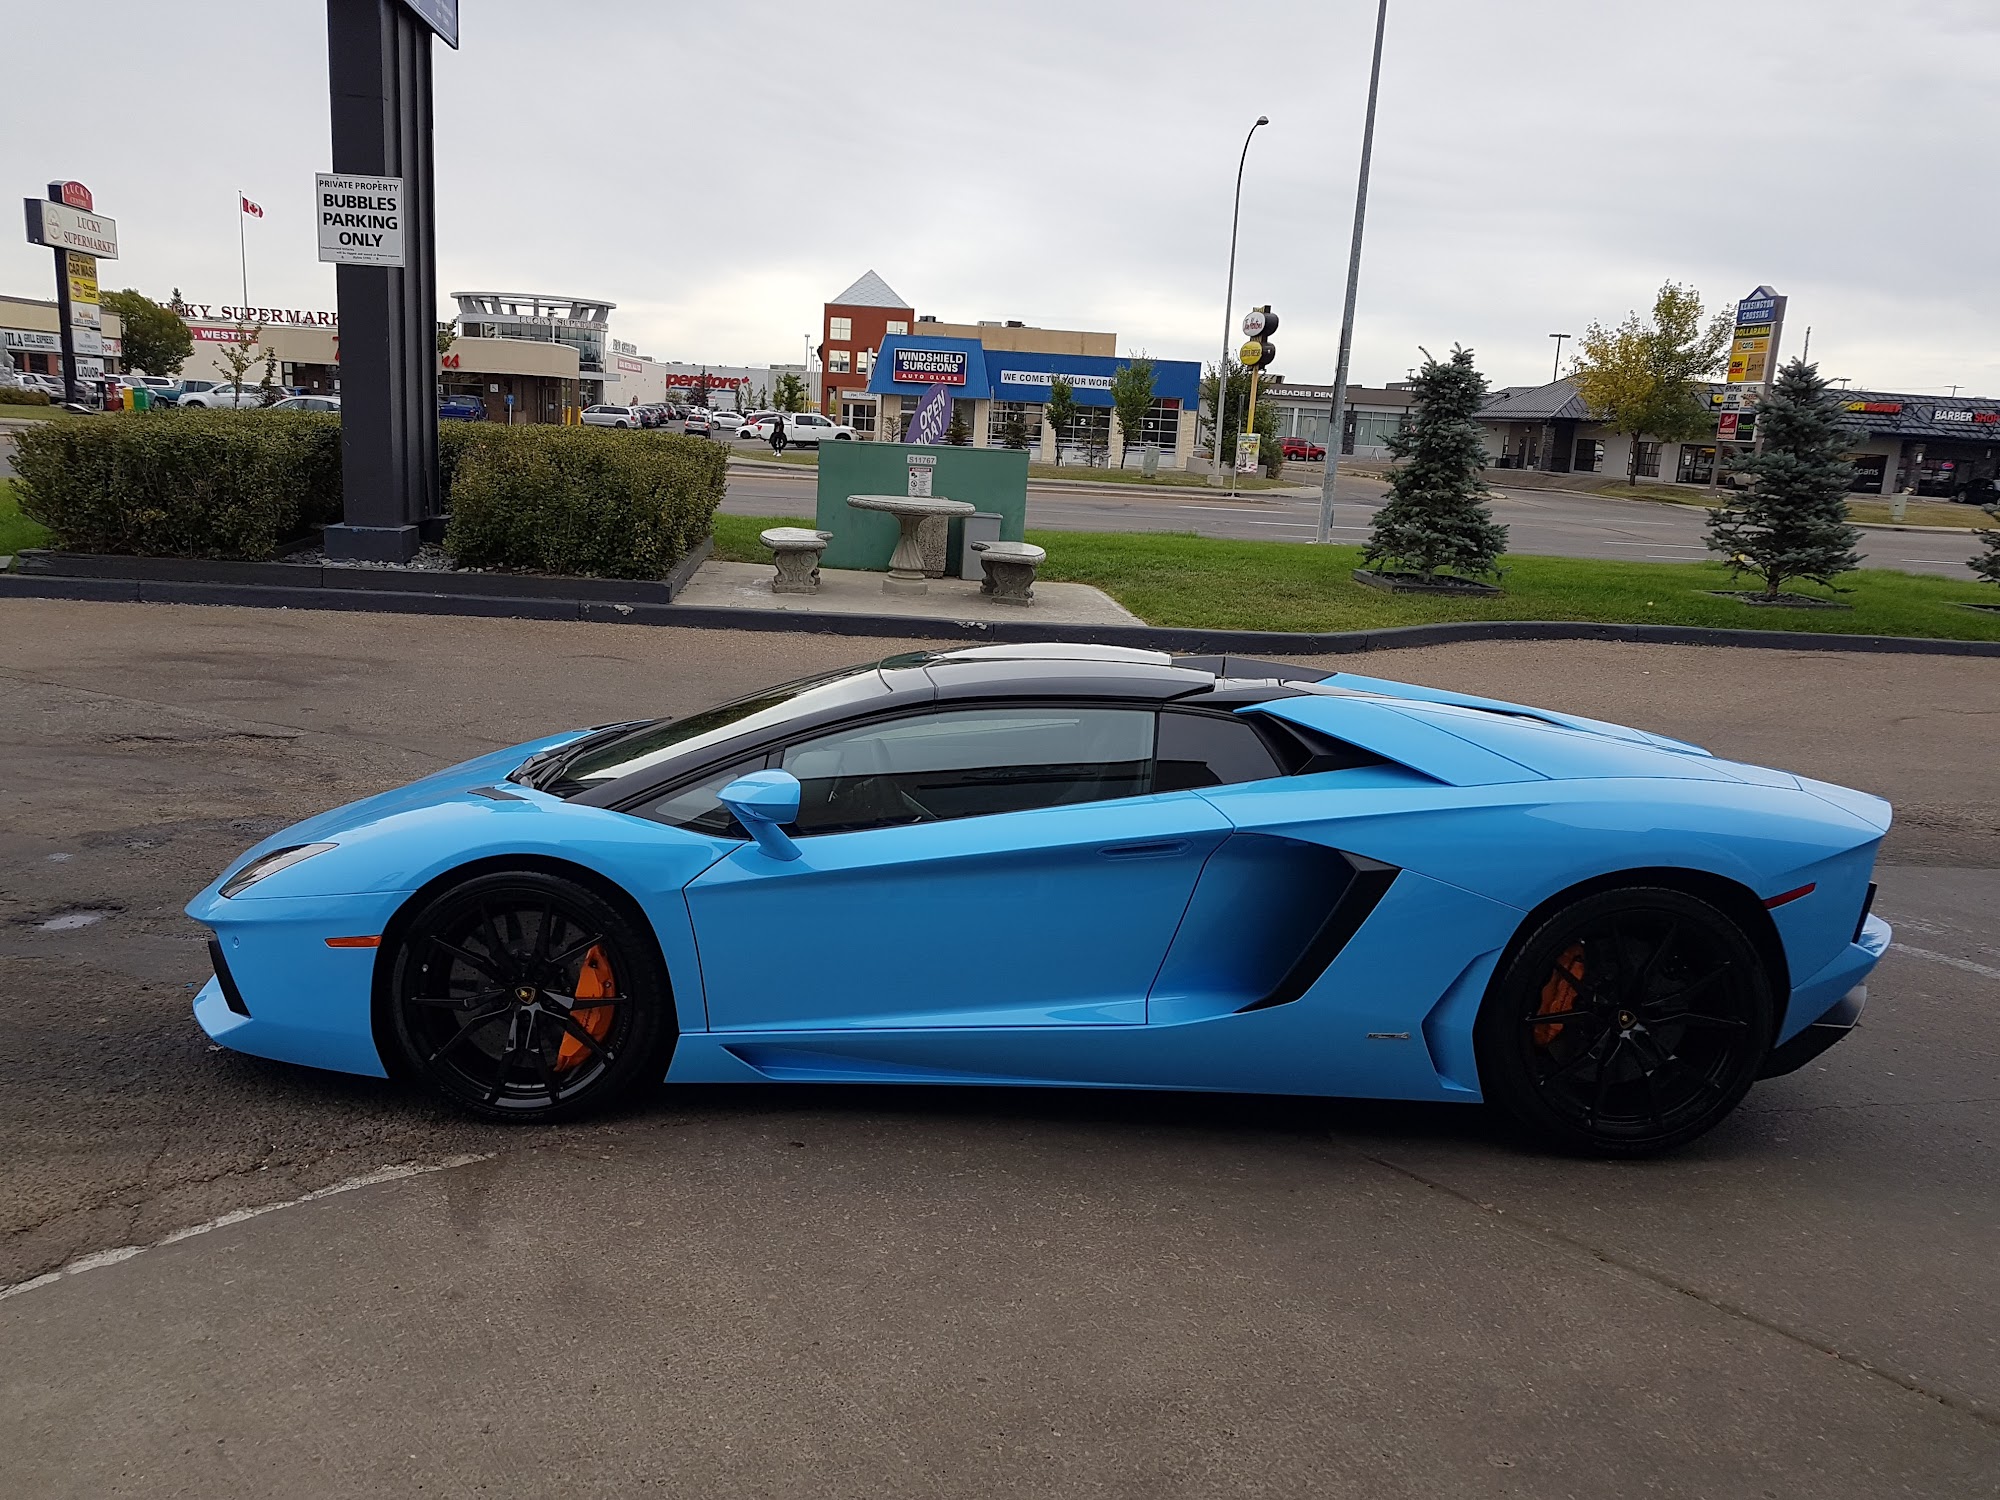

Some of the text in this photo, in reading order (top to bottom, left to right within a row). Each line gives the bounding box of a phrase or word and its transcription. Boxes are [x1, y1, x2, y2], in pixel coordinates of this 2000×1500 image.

[319, 180, 399, 191] PRIVATE PROPERTY
[65, 184, 90, 200] LUCKY
[323, 194, 397, 211] BUBBLES
[77, 216, 101, 233] LUCKY
[323, 212, 398, 230] PARKING
[63, 231, 116, 254] SUPERMARKET
[339, 232, 383, 247] ONLY
[1740, 299, 1775, 311] KENSINGTON
[519, 316, 553, 326] LUCKY
[1741, 309, 1770, 321] CROSSING
[1735, 326, 1771, 337] DOLLARAMA
[5, 331, 23, 347] ILA
[24, 333, 54, 345] GRILL EXPRESS
[898, 351, 963, 364] WINDSHIELD
[78, 366, 99, 378] LIQUOR
[902, 361, 958, 373] SURGEONS
[929, 374, 958, 382] GLASS
[1003, 373, 1017, 381] WE
[1019, 374, 1045, 382] COME
[1263, 389, 1312, 398] PALISADES
[919, 389, 946, 430] OPEN
[1843, 401, 1866, 411] ASH
[1079, 418, 1086, 426] 2
[1934, 411, 2000, 425] BARBER SHOP
[1148, 421, 1154, 429] 3
[909, 456, 935, 464] S11767
